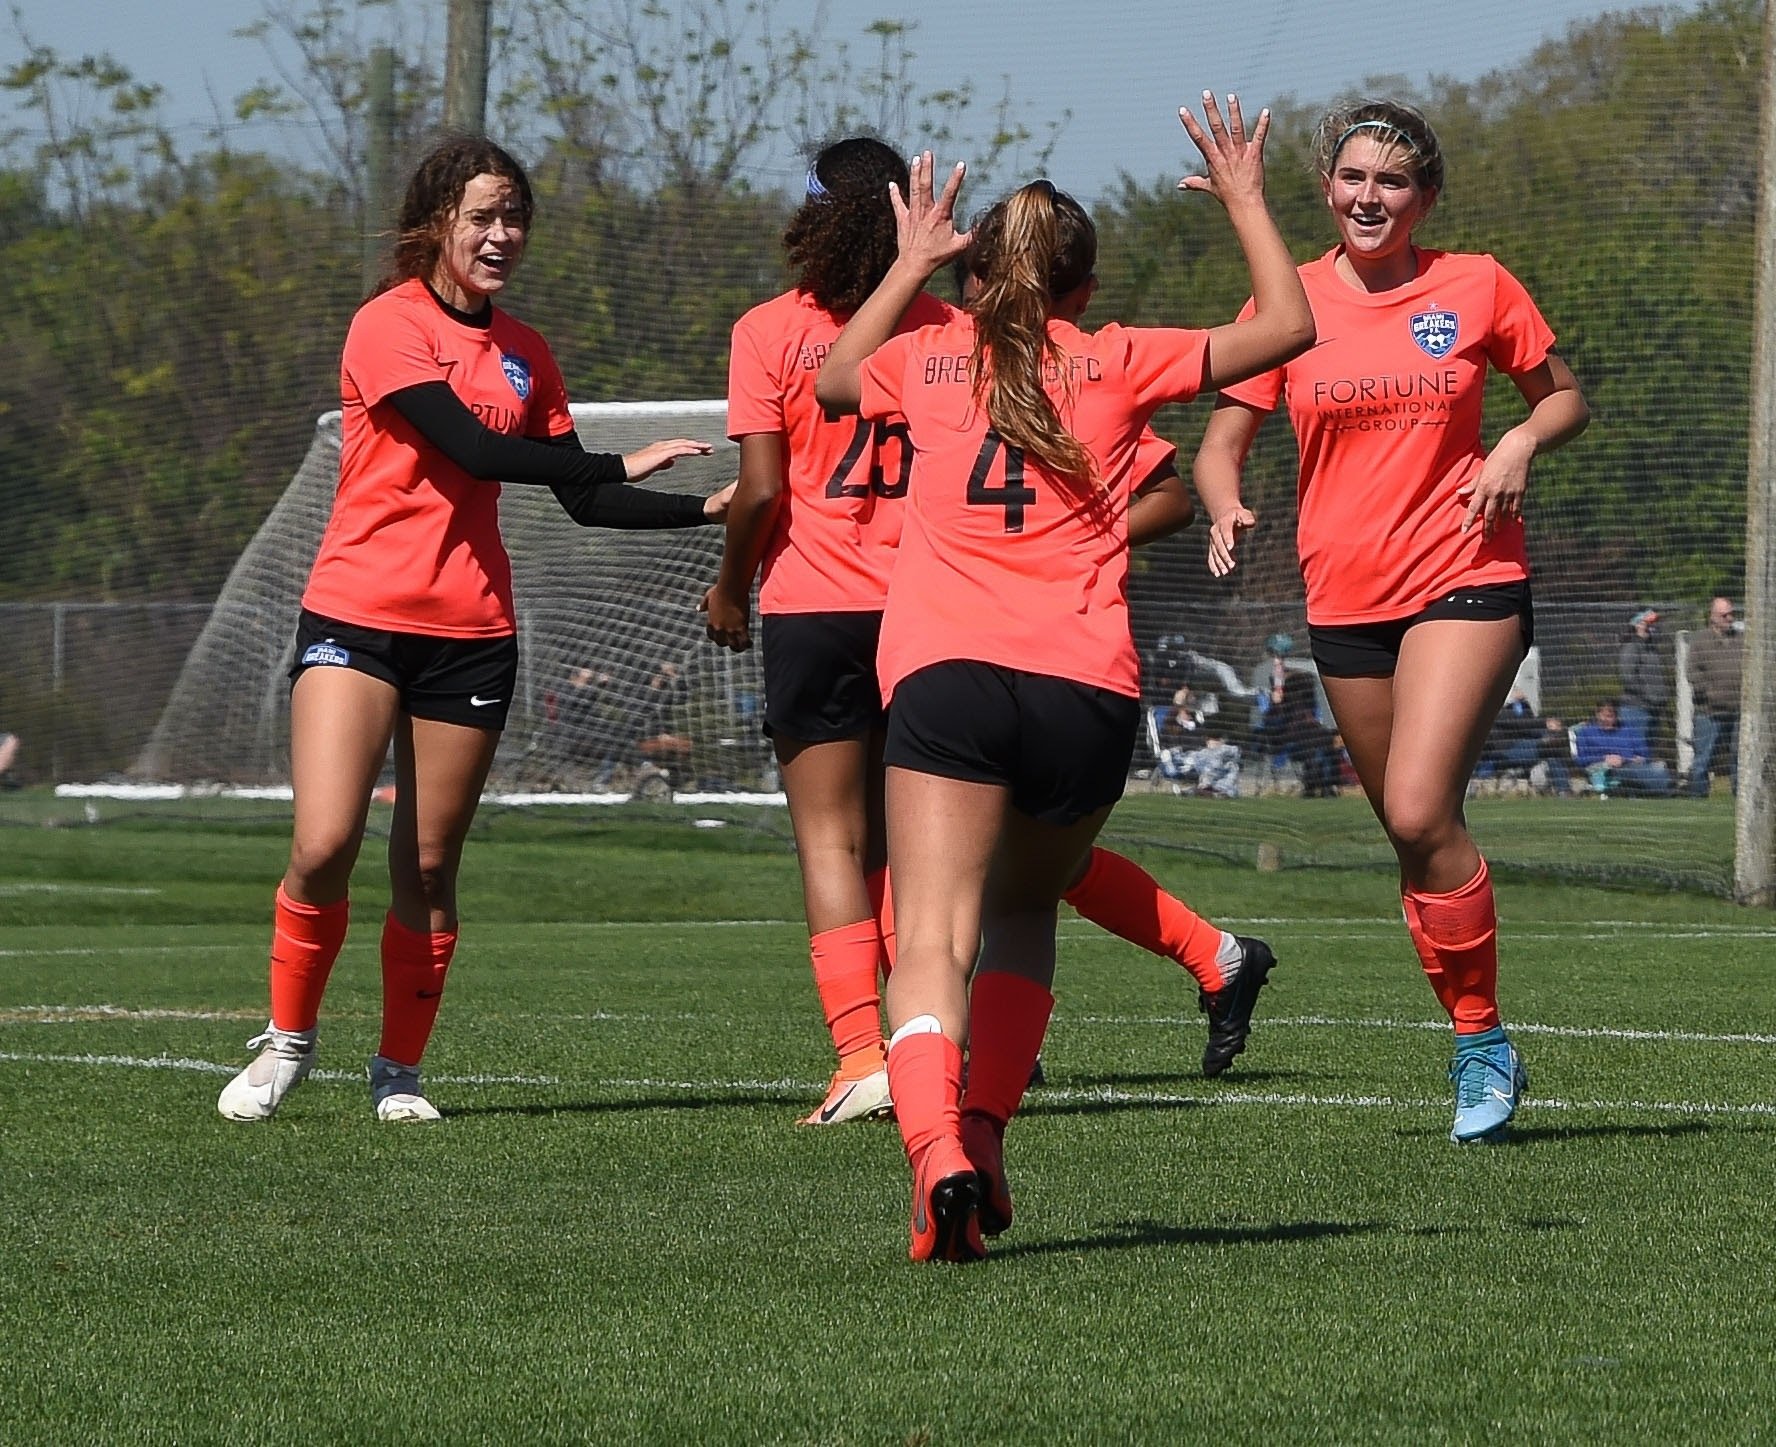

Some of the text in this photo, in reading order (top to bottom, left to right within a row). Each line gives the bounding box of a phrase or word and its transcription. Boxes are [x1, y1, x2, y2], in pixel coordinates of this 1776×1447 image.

[1314, 371, 1457, 405] FORTUNE
[1316, 400, 1454, 421] INTERNATIONAL
[1358, 419, 1419, 432] GROUP
[824, 408, 914, 498] 25
[967, 425, 1037, 533] 4
